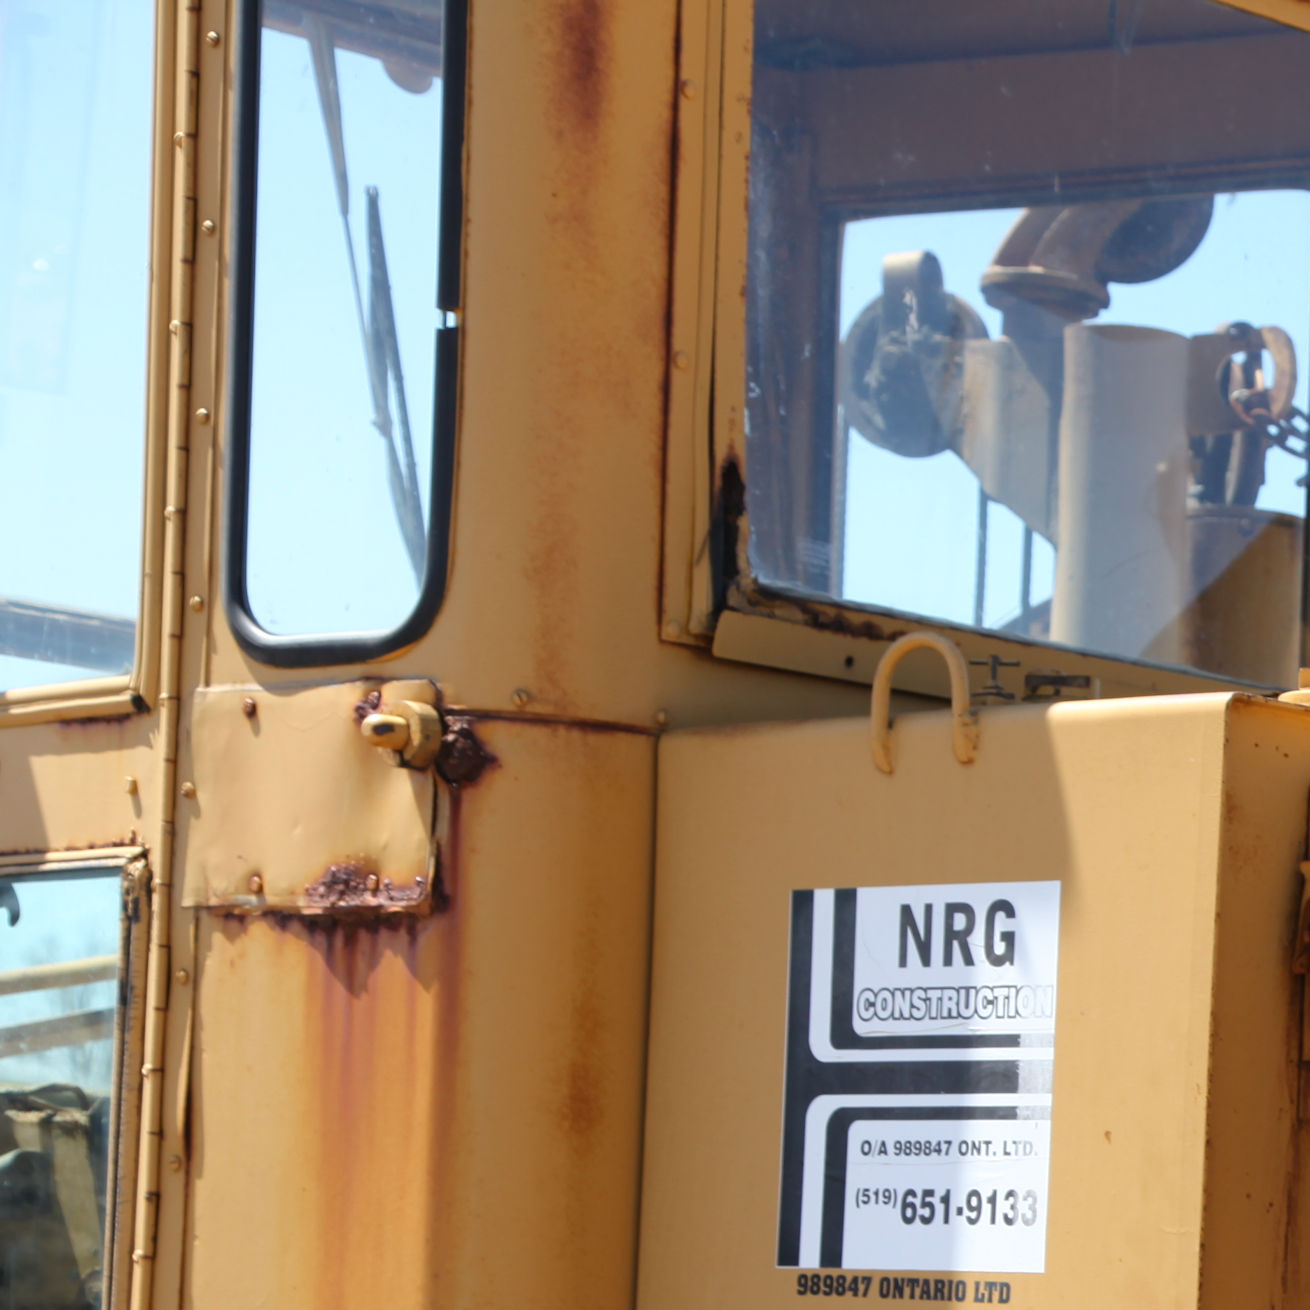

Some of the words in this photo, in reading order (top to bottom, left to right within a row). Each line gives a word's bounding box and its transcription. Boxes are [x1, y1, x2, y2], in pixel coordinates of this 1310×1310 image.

[898, 898, 1016, 968] NRG
[857, 985, 1054, 1021] CONSTRUCTION
[860, 1140, 888, 1157] O/A
[893, 1140, 952, 1157] 989847
[958, 1140, 997, 1157] ONT.
[856, 1188, 898, 1208] (519)
[900, 1188, 1038, 1226] 651-9133
[796, 1273, 872, 1298] 989847
[878, 1276, 967, 1302] ONTARIO
[973, 1280, 1011, 1304] LTD
